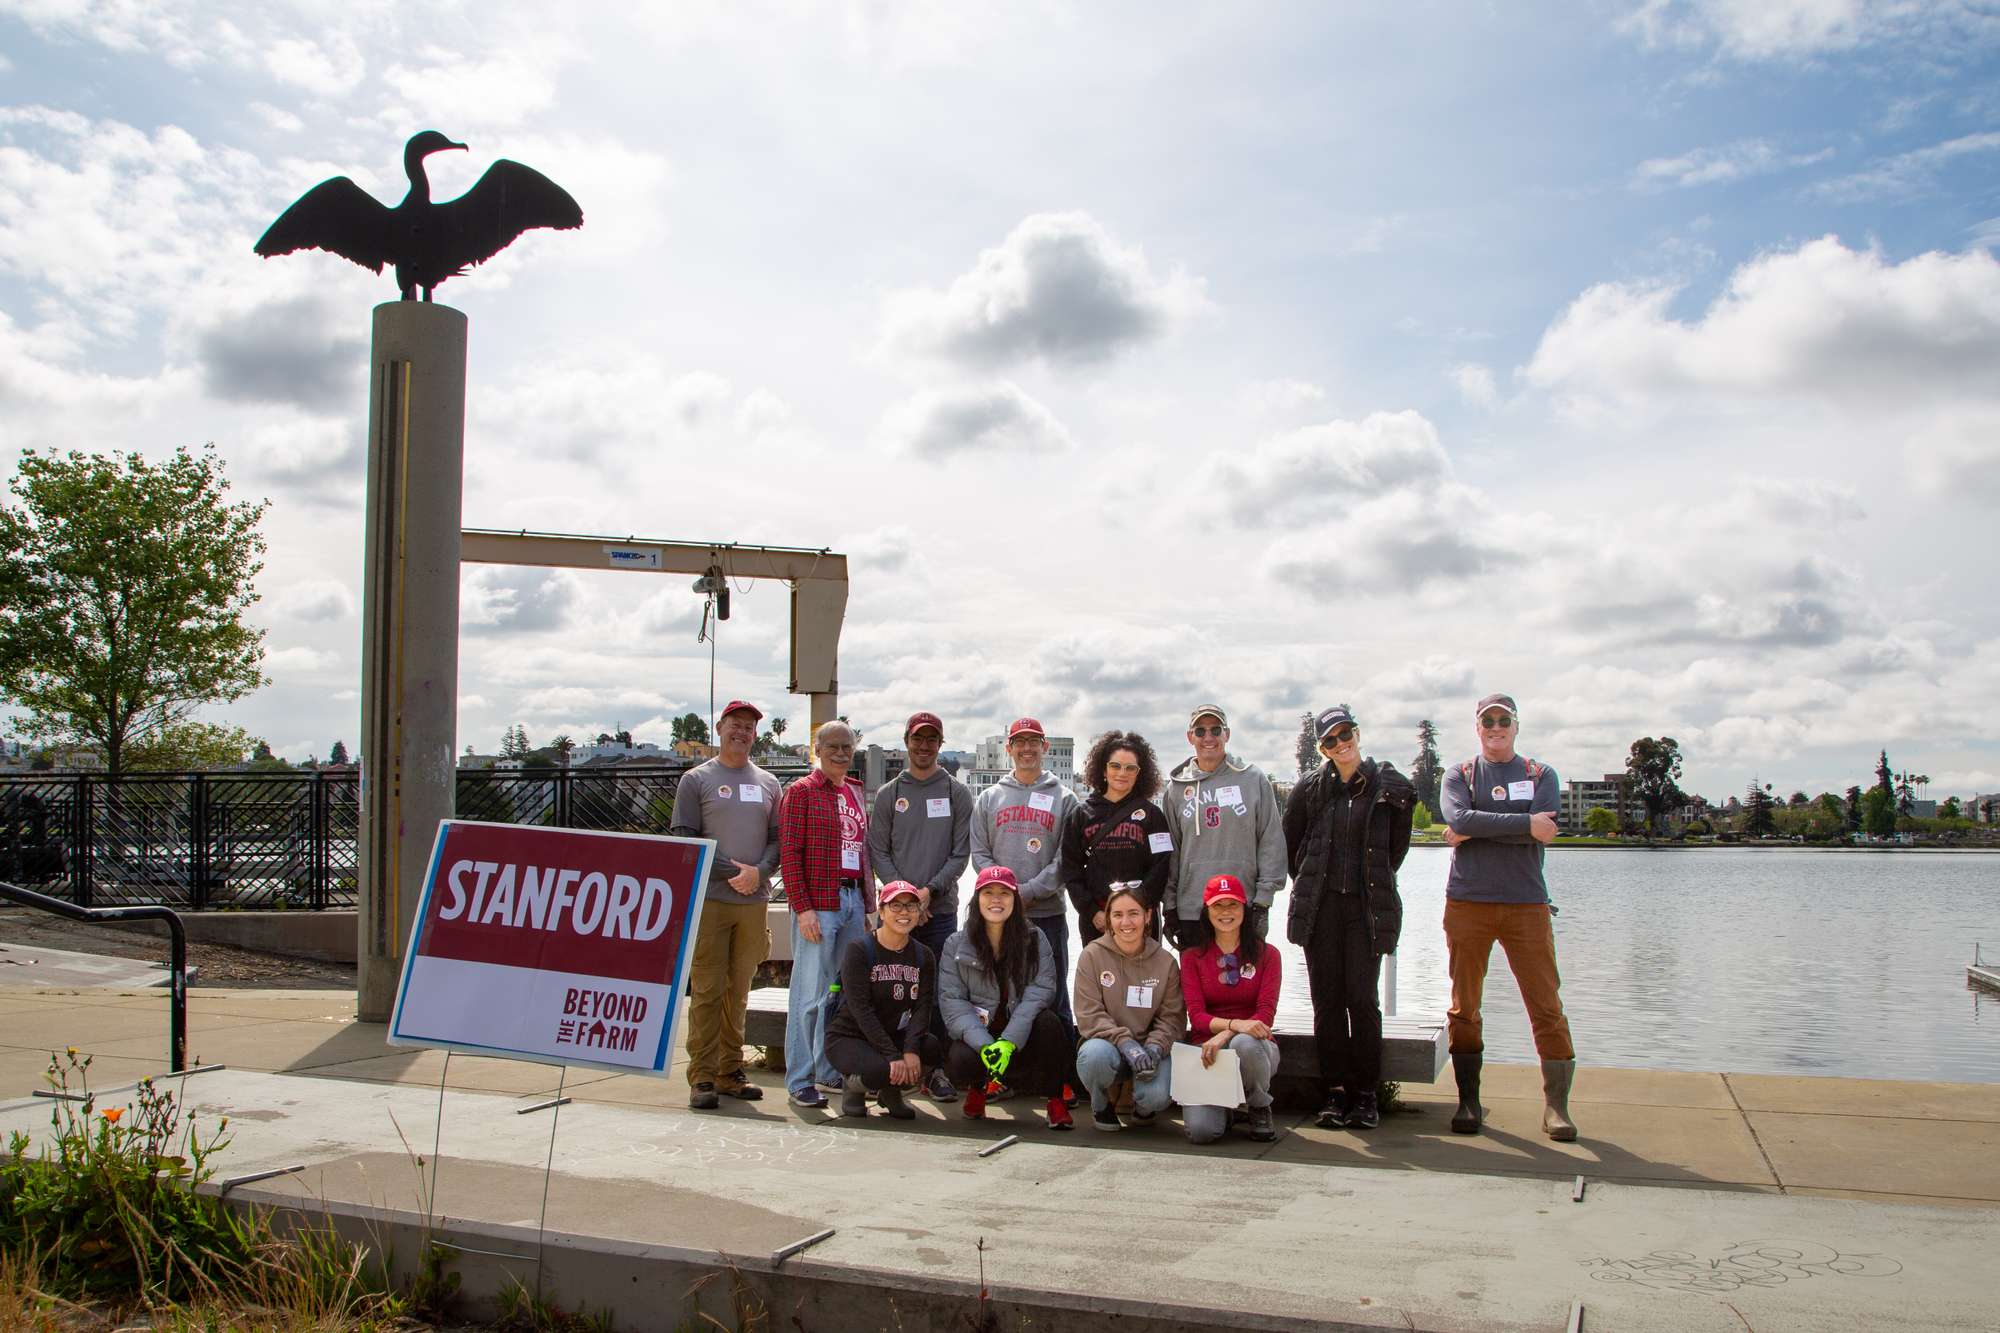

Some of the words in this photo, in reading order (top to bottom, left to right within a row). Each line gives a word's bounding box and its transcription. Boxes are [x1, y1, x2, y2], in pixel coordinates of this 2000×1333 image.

[439, 859, 673, 941] STANFORD
[563, 988, 648, 1023] BEYOND
[556, 1019, 575, 1043] THE
